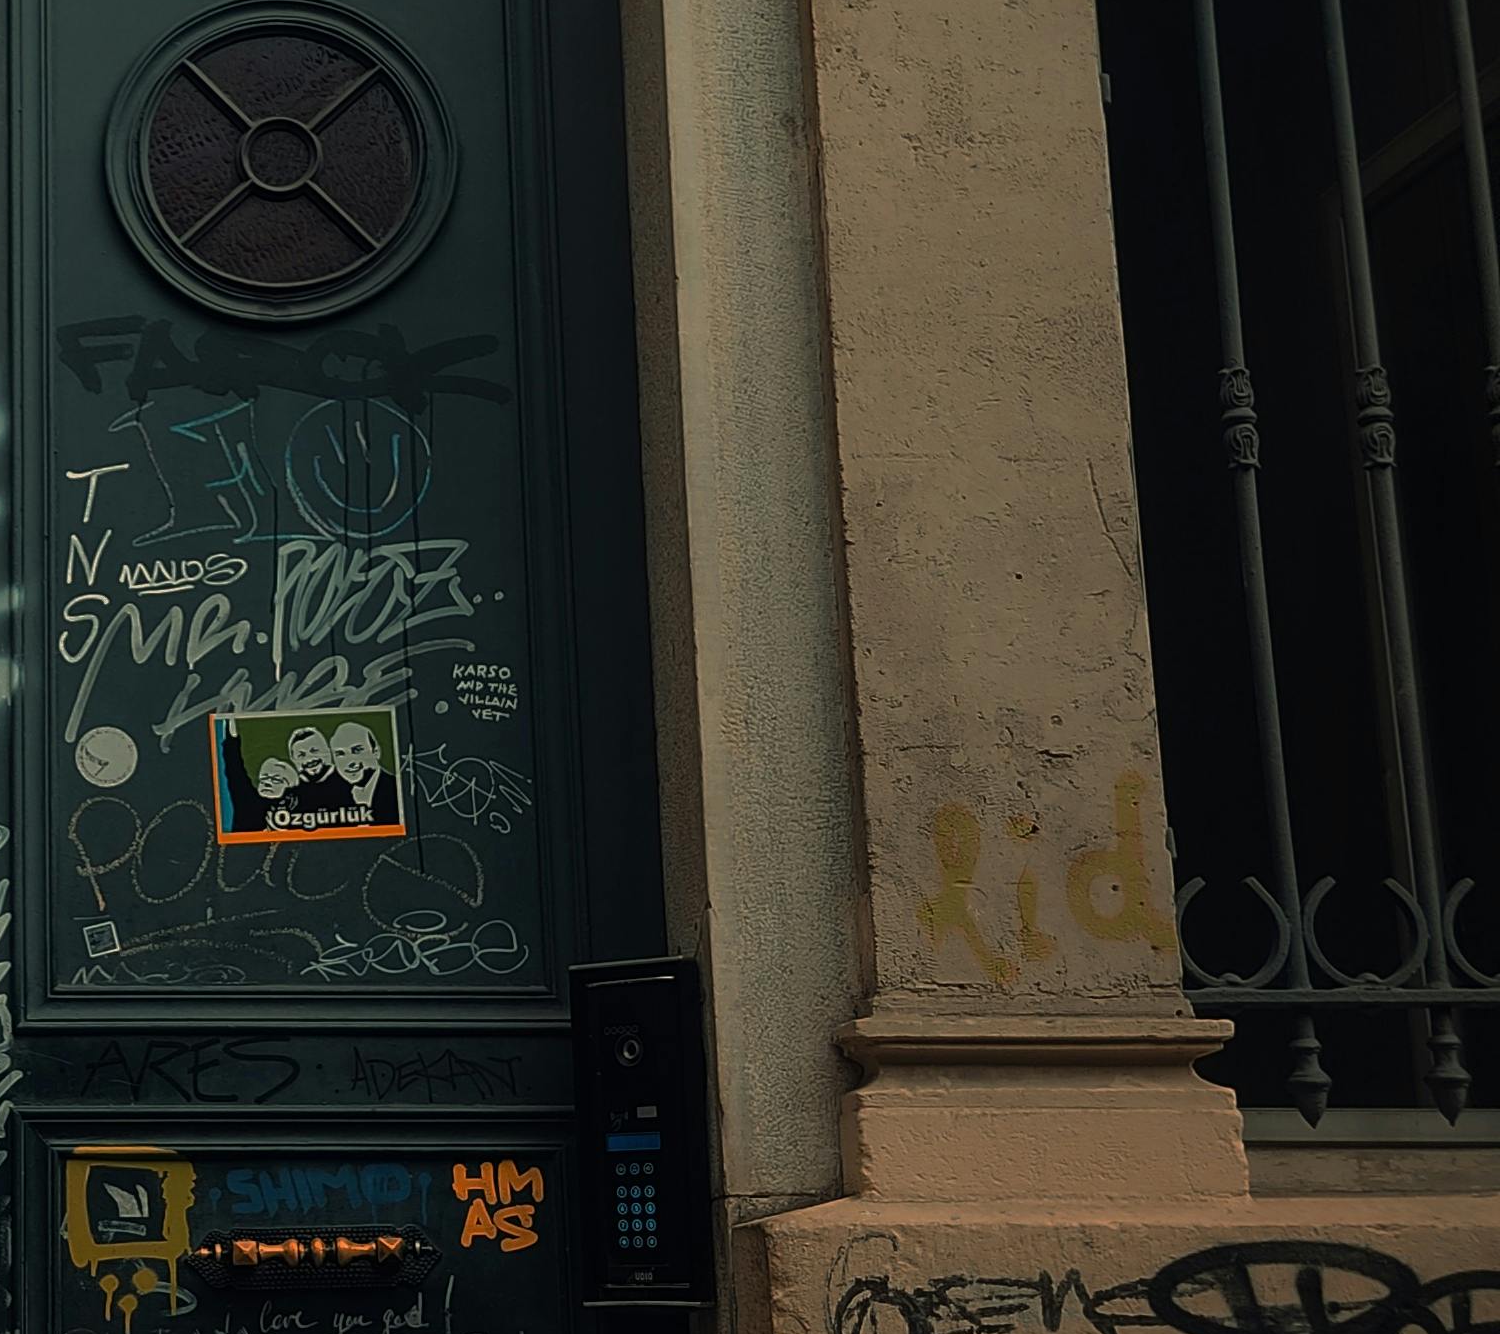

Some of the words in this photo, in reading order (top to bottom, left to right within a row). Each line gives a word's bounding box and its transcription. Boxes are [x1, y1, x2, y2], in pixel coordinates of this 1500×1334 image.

[452, 663, 512, 681] KARSO
[455, 679, 485, 692] AND
[487, 682, 519, 697] THE
[273, 804, 377, 830] Özgürlük
